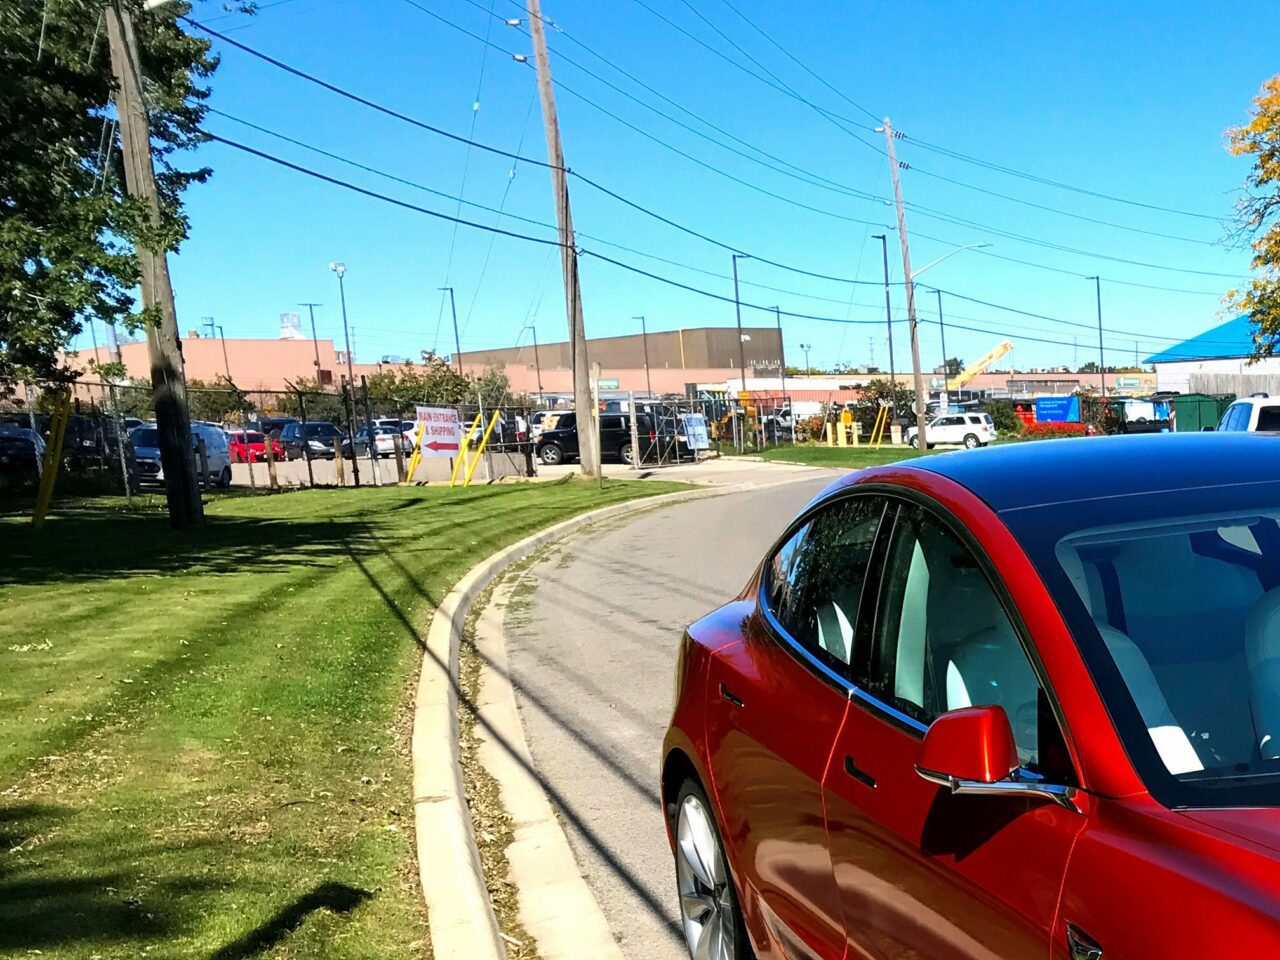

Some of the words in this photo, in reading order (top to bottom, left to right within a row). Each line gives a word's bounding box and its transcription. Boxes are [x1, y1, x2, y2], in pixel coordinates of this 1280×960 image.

[419, 412, 432, 422] MAIN
[433, 413, 458, 424] ENTRANCE
[431, 426, 456, 436] SHIPPING
